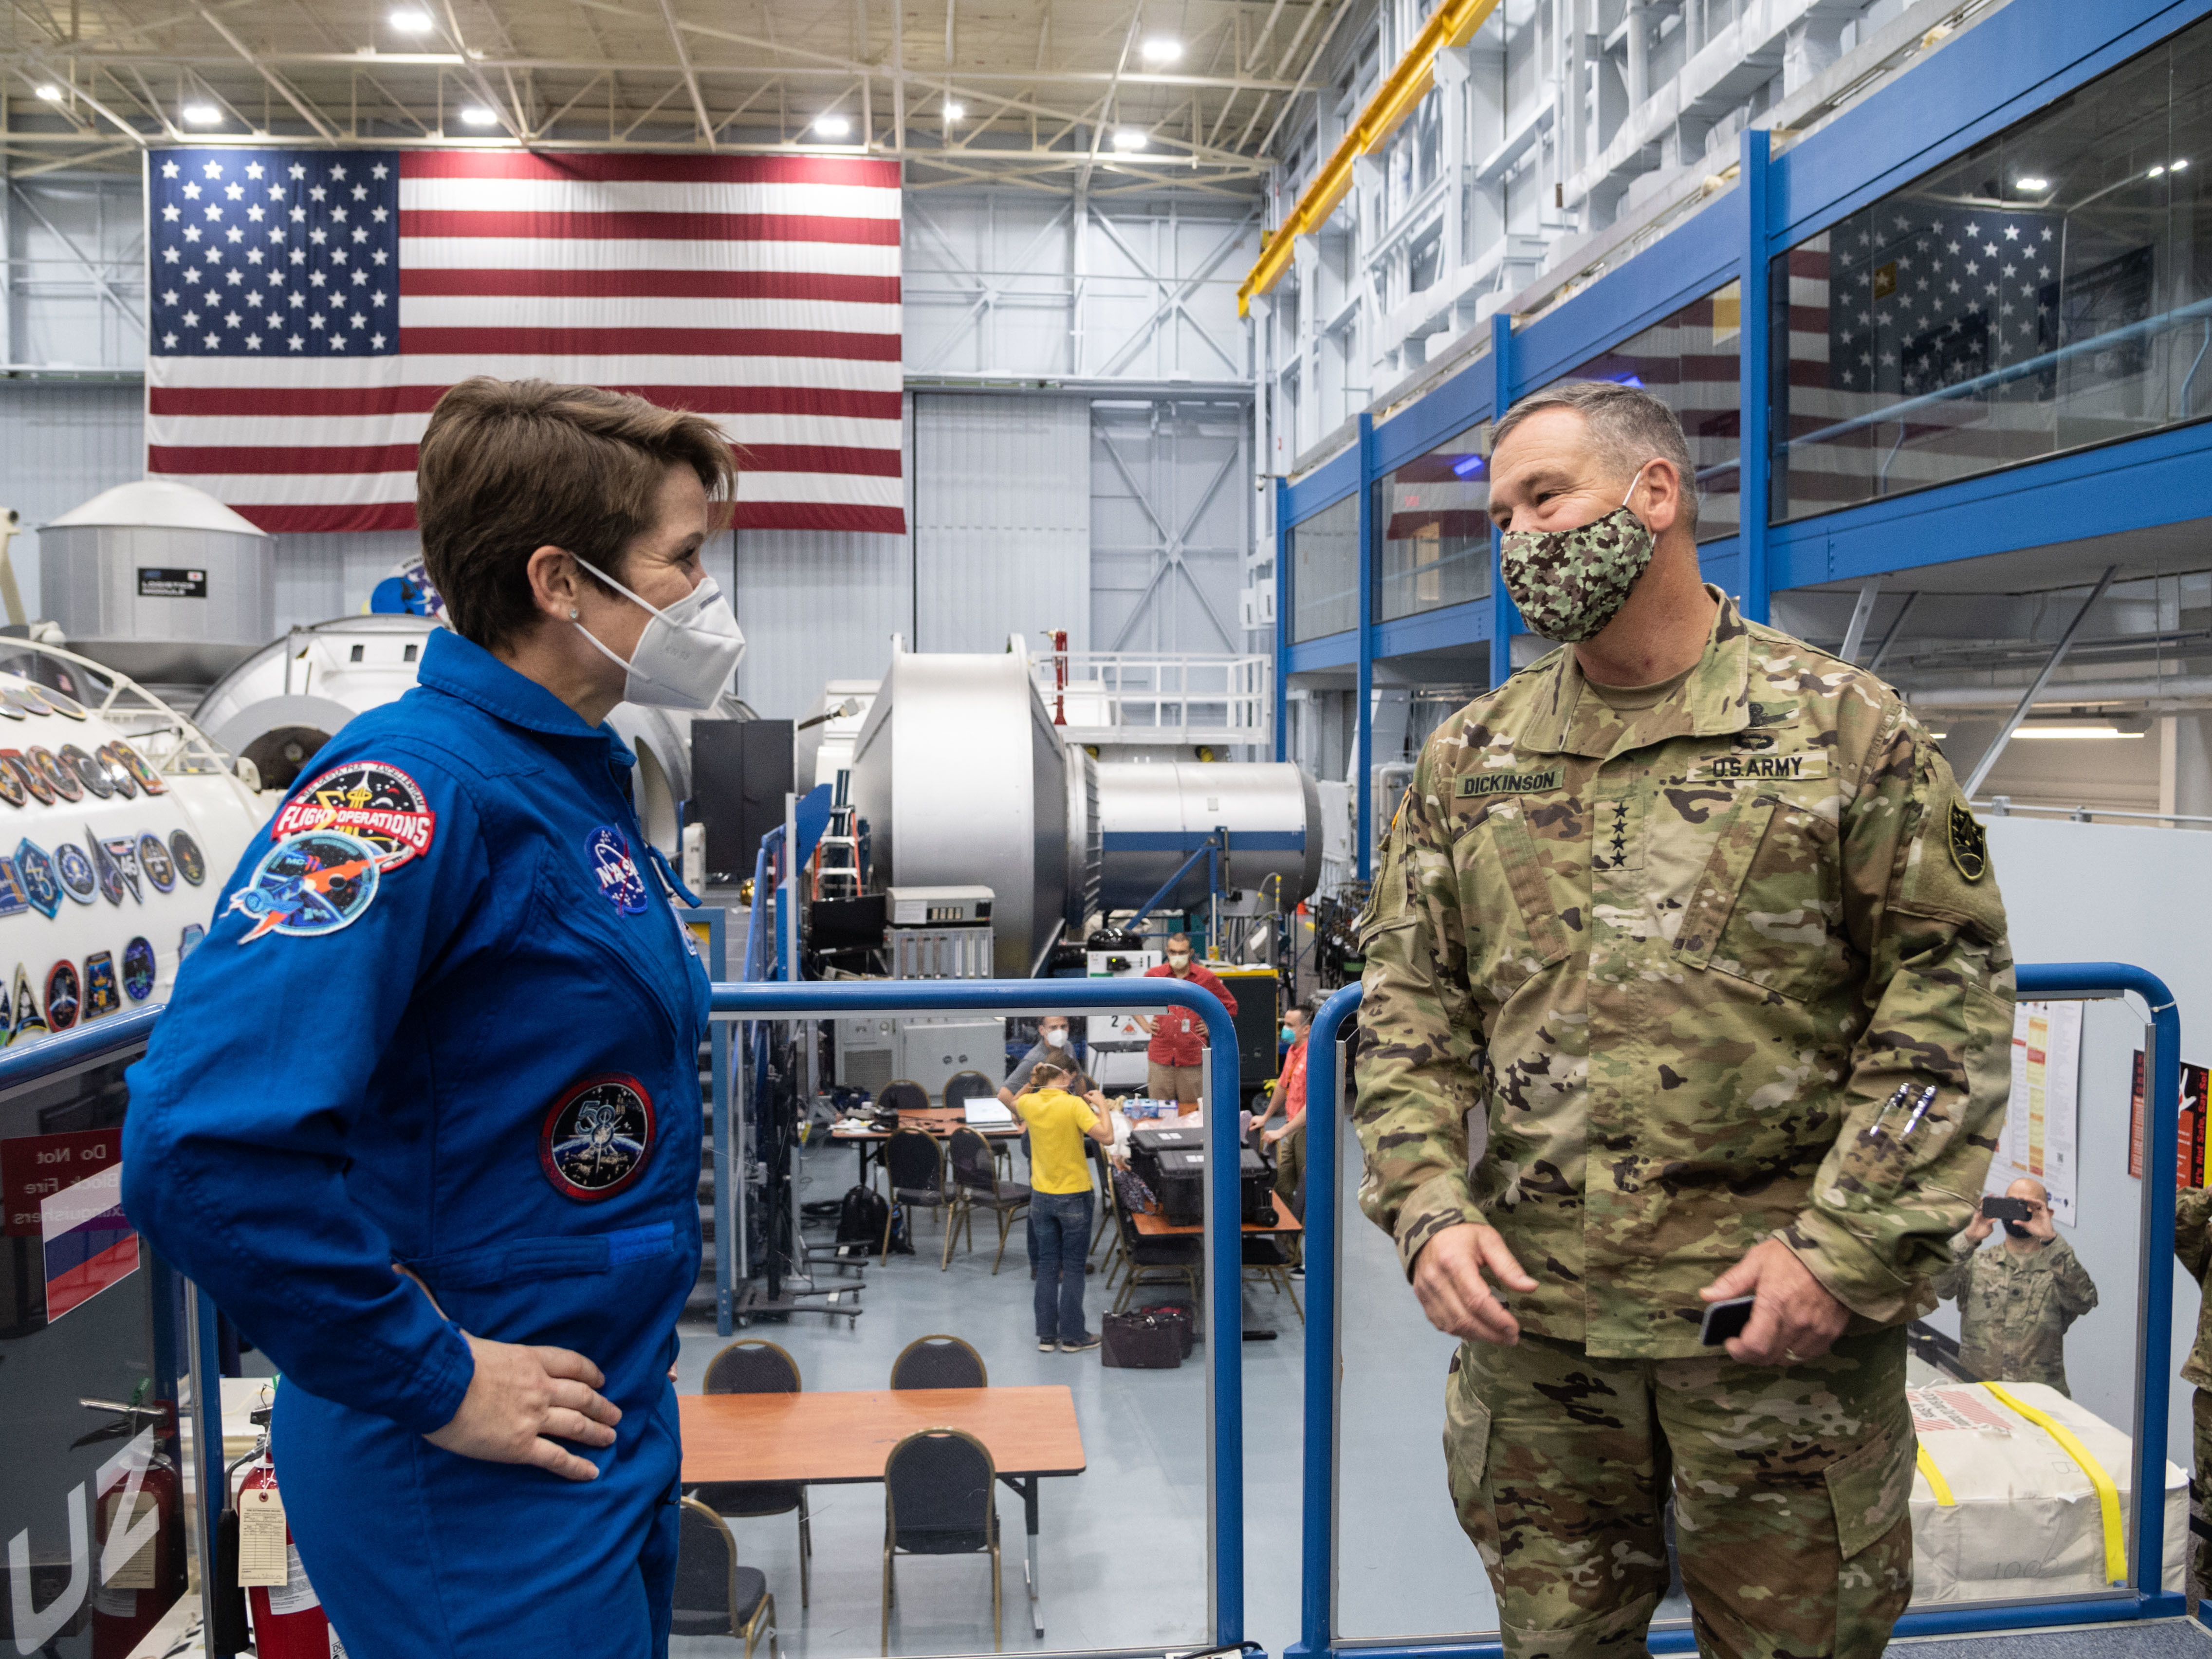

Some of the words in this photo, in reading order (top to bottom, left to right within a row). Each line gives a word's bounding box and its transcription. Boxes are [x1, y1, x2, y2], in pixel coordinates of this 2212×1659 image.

[1464, 772, 1555, 795] DICKINSON
[278, 805, 334, 832] FLIGHT
[337, 810, 431, 848] OPERATIONS
[595, 857, 639, 888] NASA
[1111, 1015, 1118, 1028] 2
[575, 1100, 616, 1148] 58
